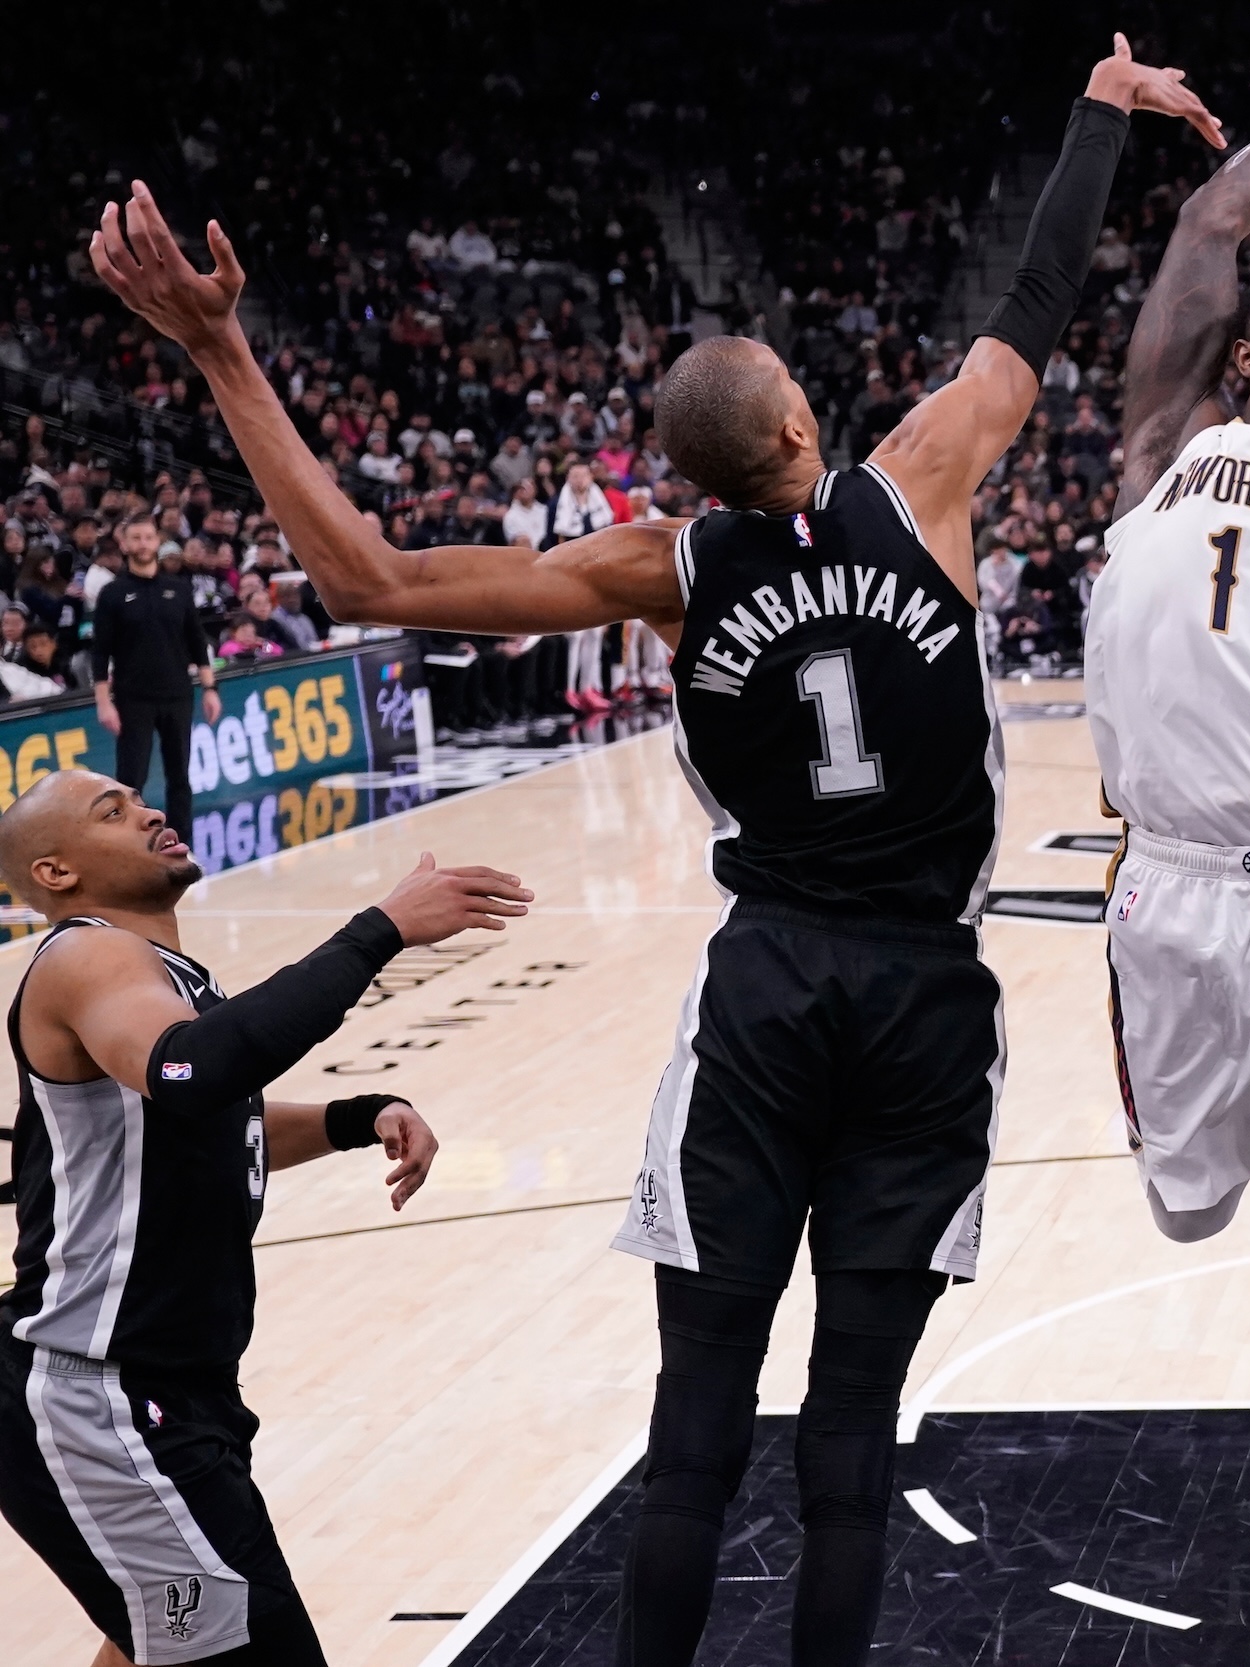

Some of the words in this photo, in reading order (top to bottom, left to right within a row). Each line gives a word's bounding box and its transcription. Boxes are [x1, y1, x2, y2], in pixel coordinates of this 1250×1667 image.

[690, 565, 960, 697] WEMBANYAMA
[1208, 526, 1242, 635] 1
[188, 673, 353, 795] bet365
[795, 648, 886, 800] 1
[321, 960, 588, 1076] CENTER
[245, 1115, 264, 1199] 3
